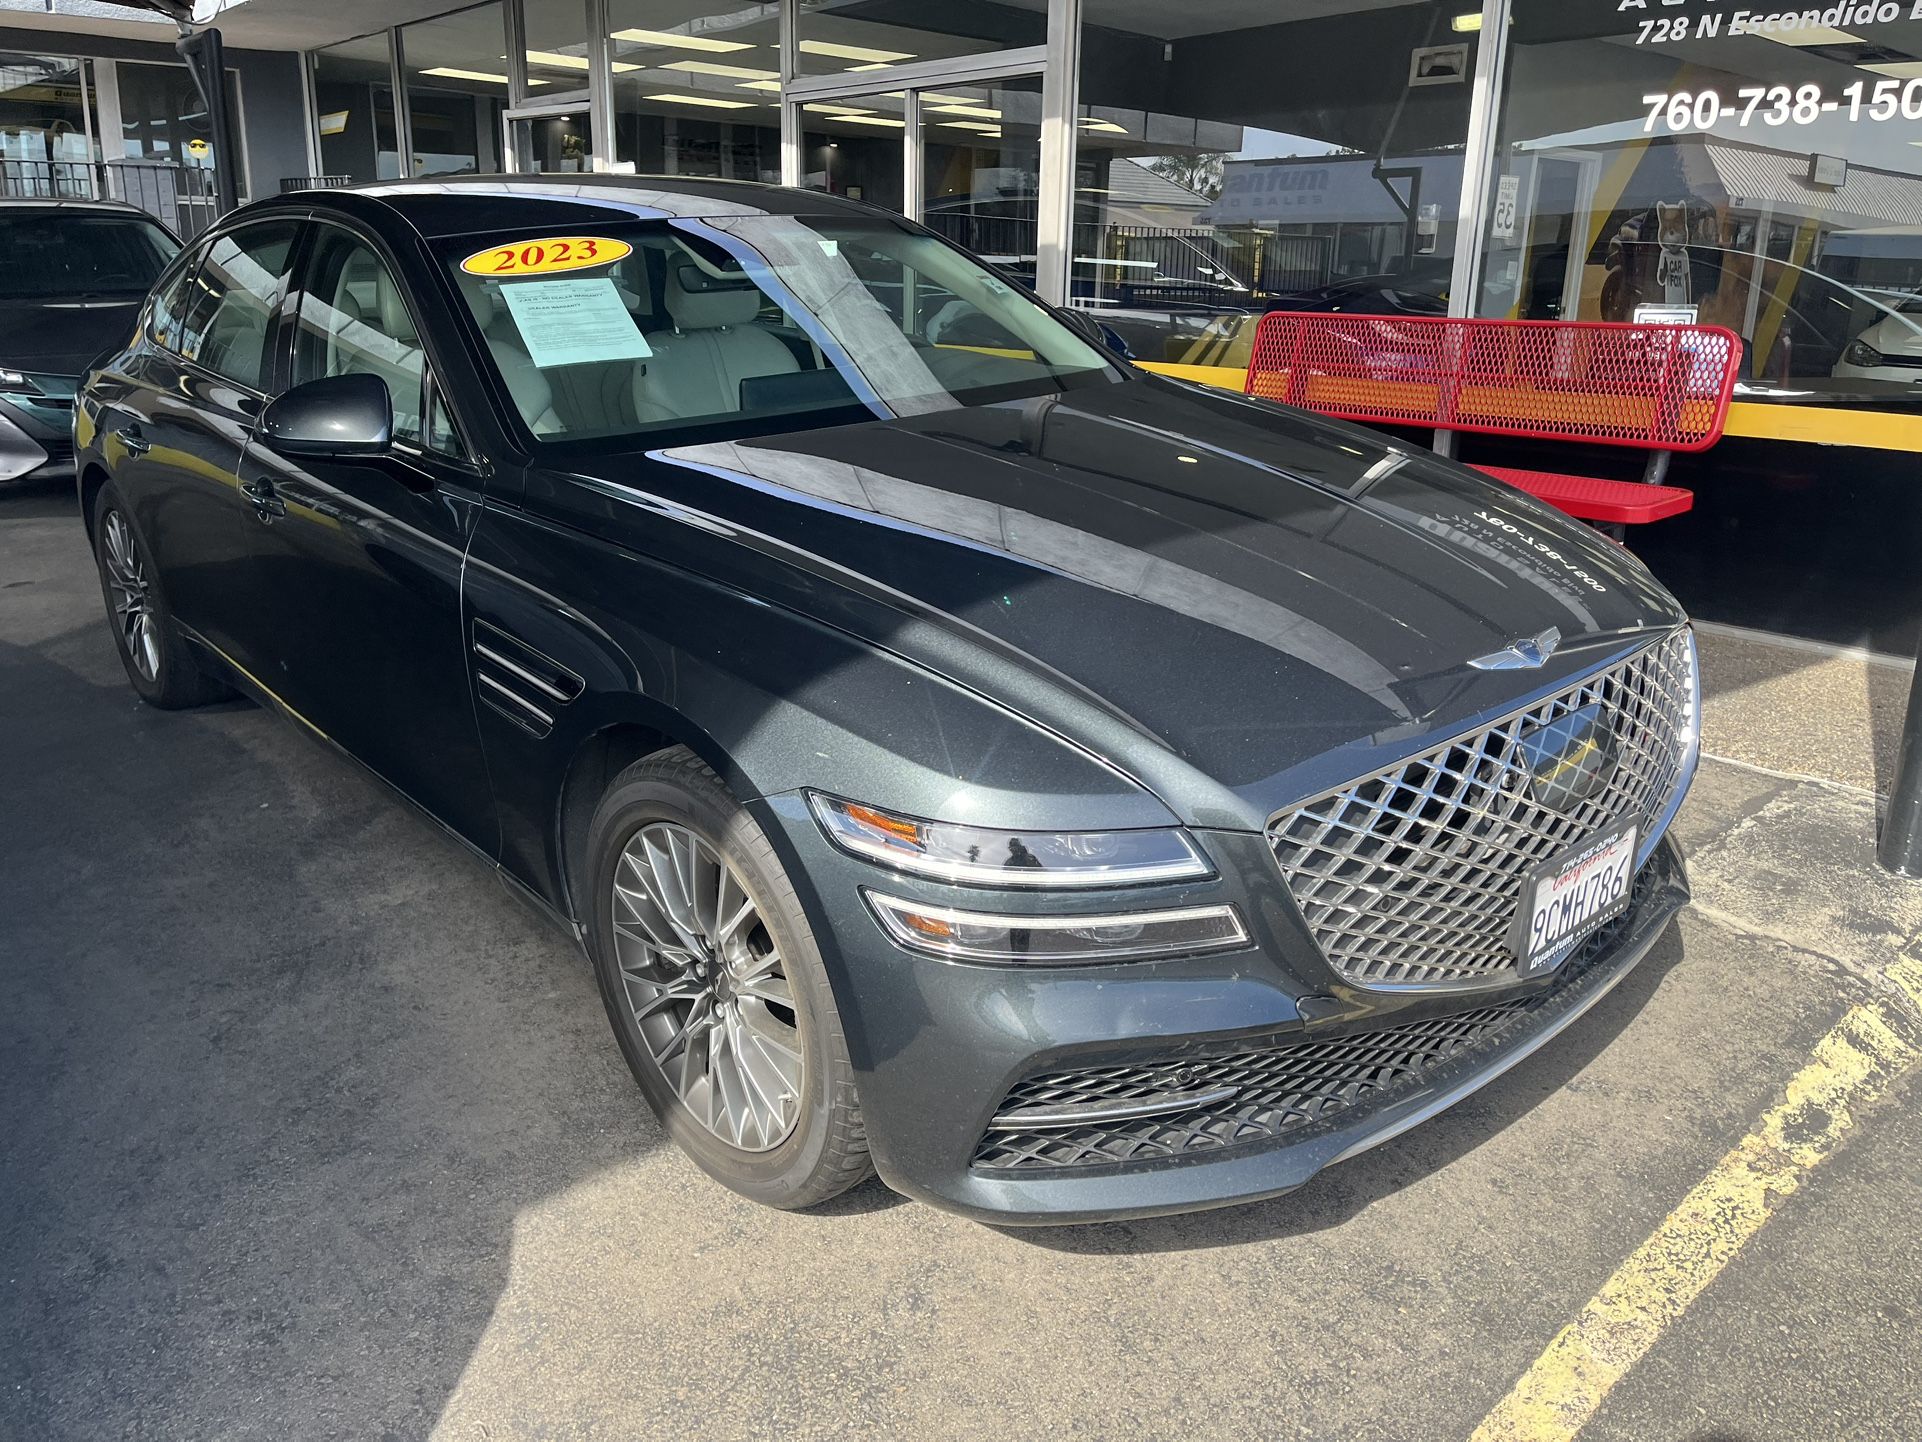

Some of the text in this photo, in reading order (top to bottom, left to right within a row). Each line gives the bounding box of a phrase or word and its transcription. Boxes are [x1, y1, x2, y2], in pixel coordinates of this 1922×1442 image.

[1635, 15, 1688, 46] 728
[1695, 13, 1723, 40] N
[1727, 0, 1901, 37] Escondido
[1252, 194, 1323, 207] SALES
[492, 240, 598, 272] 2023
[1669, 260, 1682, 273] CAR
[1669, 274, 1683, 288] FOX
[1528, 854, 1628, 957] 9CMH786
[1529, 933, 1574, 970] Quantum
[1576, 921, 1597, 937] AUTO
